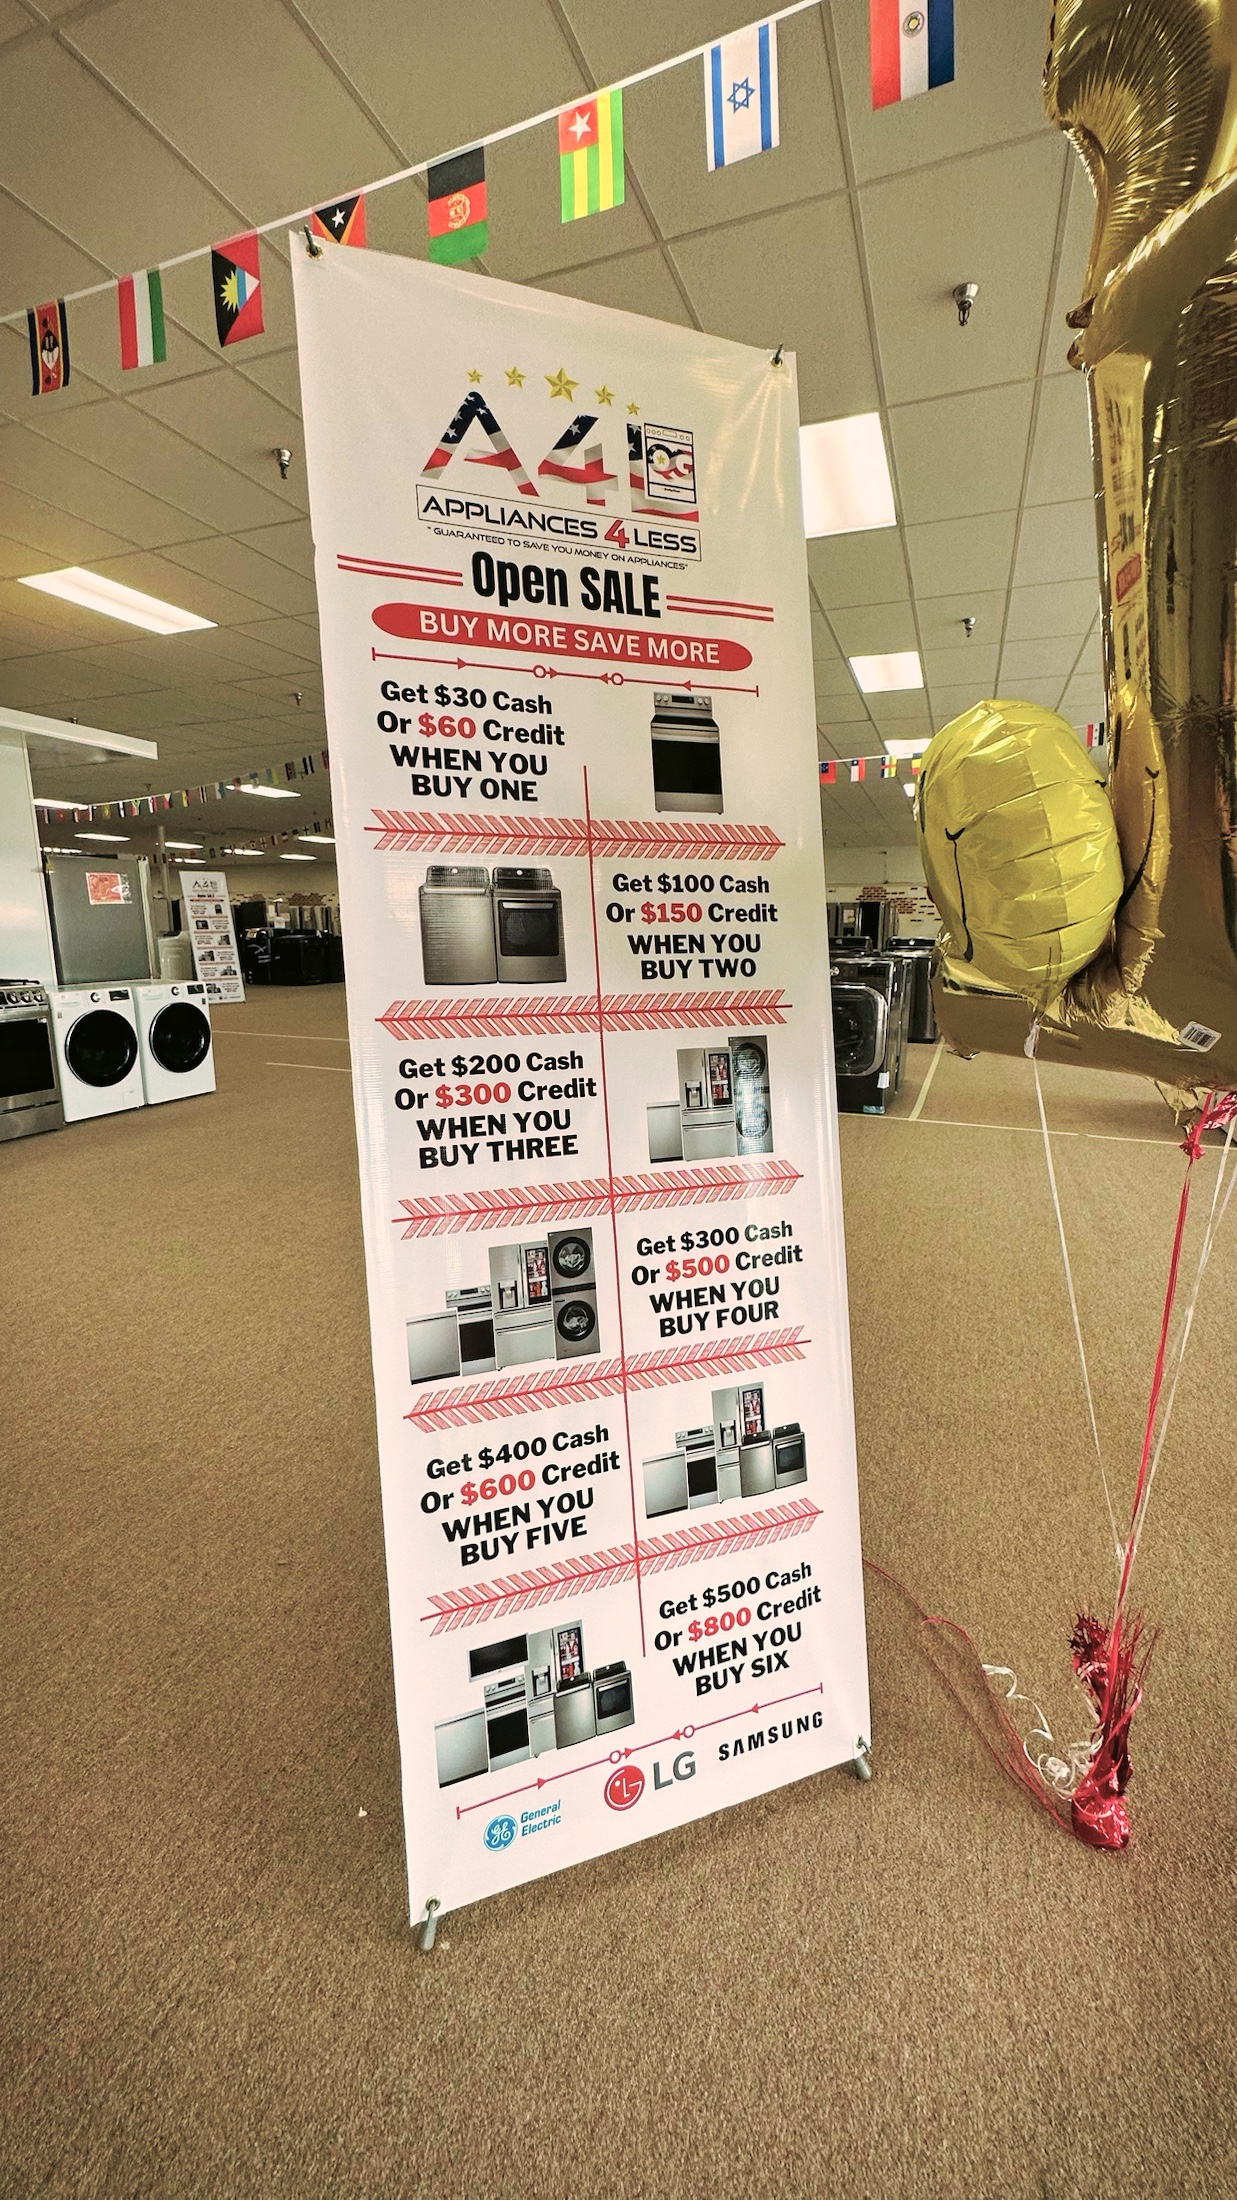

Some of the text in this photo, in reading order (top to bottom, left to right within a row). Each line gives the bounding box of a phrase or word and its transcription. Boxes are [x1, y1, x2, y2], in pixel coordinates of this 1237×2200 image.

[422, 496, 696, 553] APPLIANCES 4 LESS
[507, 538, 520, 547] TO
[523, 541, 549, 551] SAVE
[552, 545, 572, 554] YOU
[575, 548, 609, 560] MONEY
[612, 554, 625, 562] ON
[472, 551, 661, 618] Open SALE
[420, 611, 719, 664] BUY MORE SAVE MORE
[380, 680, 552, 715] Get $30 Cash
[377, 710, 565, 746] Or $60 Credit
[390, 745, 548, 776] WHEN YOU
[412, 774, 538, 802] BUY ONE
[612, 873, 770, 895] Get $100 Cash
[606, 902, 778, 924] Or $150 Credit
[627, 934, 761, 955] WHEN YOU
[641, 958, 756, 981] BUY TWO
[399, 1051, 583, 1079] Get $200 Cash
[395, 1078, 597, 1110] Or $300 Credit
[416, 1109, 571, 1141] WHEN YOU
[419, 1135, 578, 1169] BUY THREE
[637, 1221, 792, 1256] Get $300 Cash
[631, 1245, 803, 1286] Or $500 Credit
[649, 1276, 780, 1313] WHEN YOU
[660, 1301, 779, 1338] BUY FOUR
[427, 1424, 609, 1479] Get $400 Cash
[420, 1451, 620, 1514] Or $600 Credit
[441, 1487, 594, 1543] WHEN YOU
[460, 1515, 587, 1566] BUY FIVE
[660, 1562, 811, 1619] Get $500 Cash
[655, 1585, 821, 1651] Or $800 Credit
[672, 1622, 802, 1677] WHEN YOU
[696, 1650, 790, 1696] BUY SIX
[718, 1711, 823, 1761] SAMSUNG
[653, 1751, 696, 1790] LG
[521, 1800, 561, 1823] General
[521, 1815, 561, 1837] Electric
